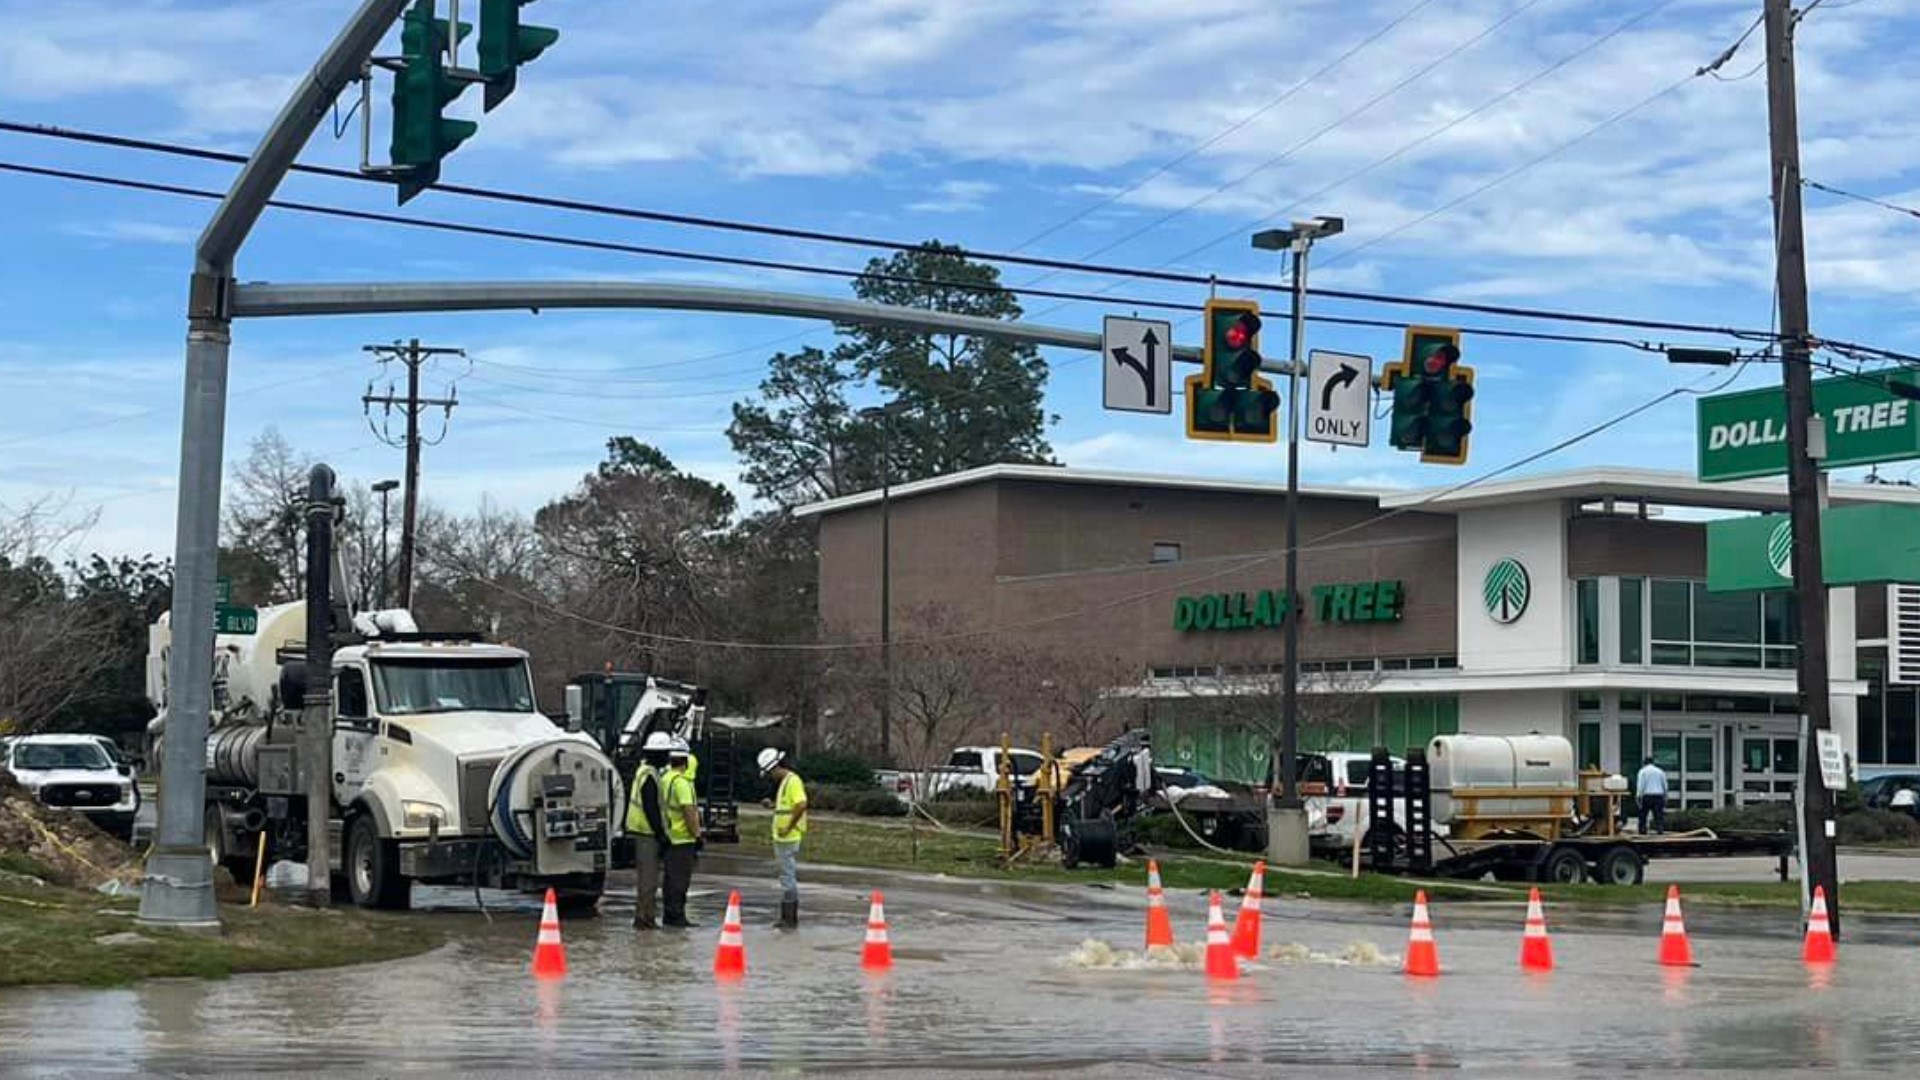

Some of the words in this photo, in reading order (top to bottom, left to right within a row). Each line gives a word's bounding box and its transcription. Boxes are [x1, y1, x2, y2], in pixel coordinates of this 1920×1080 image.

[1315, 416, 1361, 437] ONLY
[1708, 418, 1788, 451] DOLL
[1833, 400, 1909, 434] TREE
[227, 615, 255, 632] BLVD
